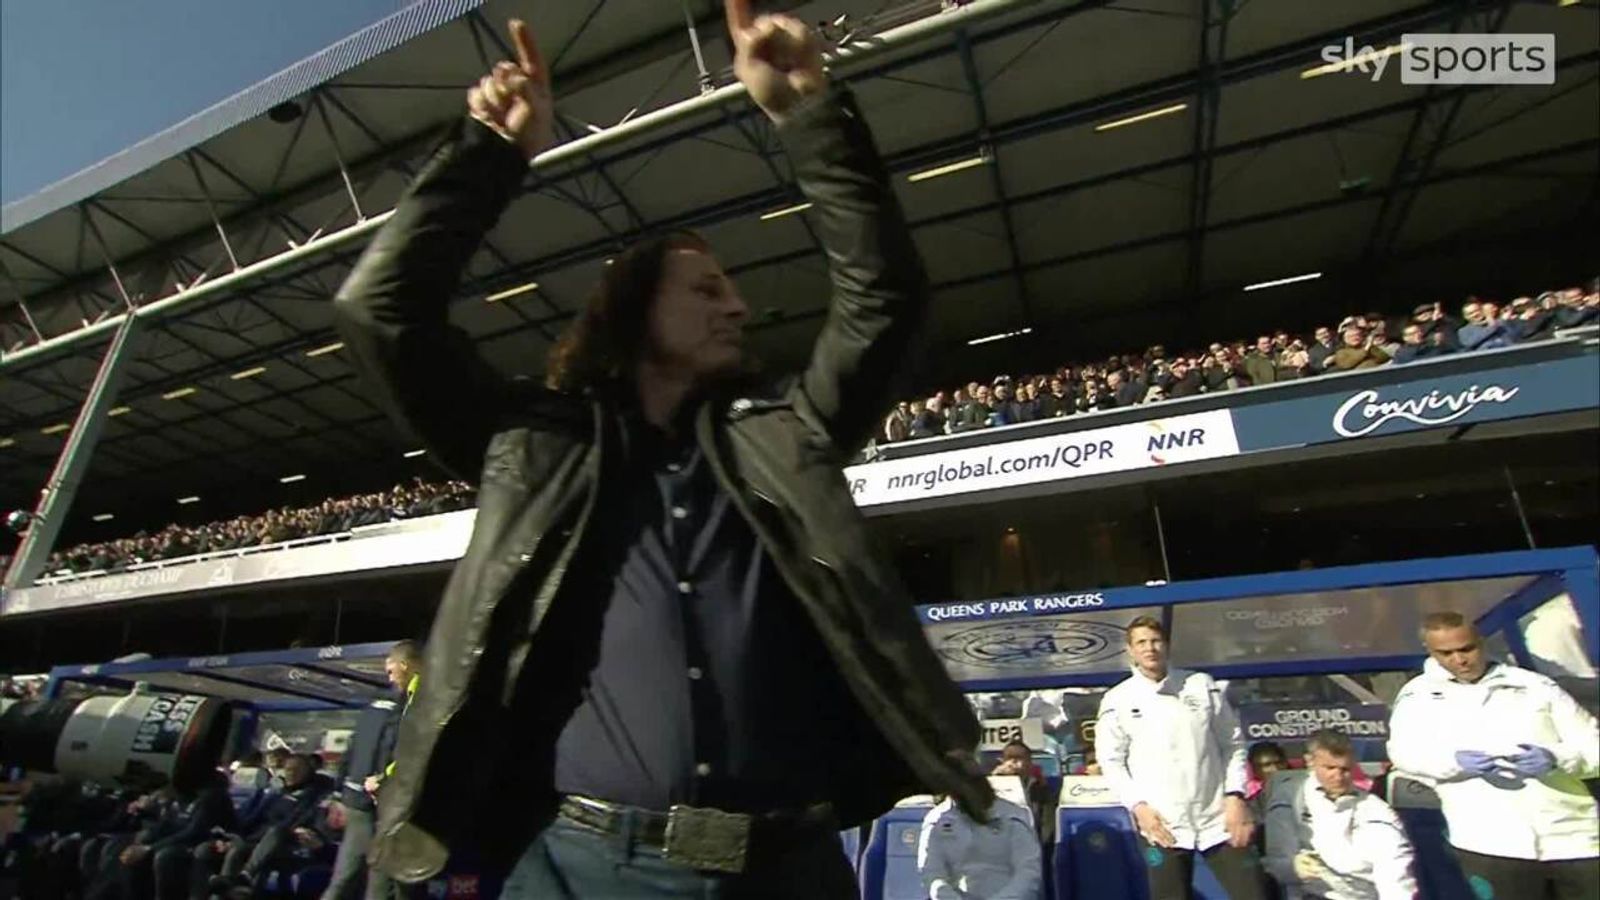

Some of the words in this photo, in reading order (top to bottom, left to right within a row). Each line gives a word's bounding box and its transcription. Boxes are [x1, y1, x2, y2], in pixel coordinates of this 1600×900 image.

[1332, 385, 1520, 438] Convivia
[887, 440, 1114, 491] nnrglobal.com/QPR
[1147, 428, 1206, 451] NNR
[927, 603, 985, 621] QUEENS
[990, 599, 1028, 614] PARK
[1033, 592, 1104, 610] RANGERS
[1274, 708, 1350, 724] GROUND
